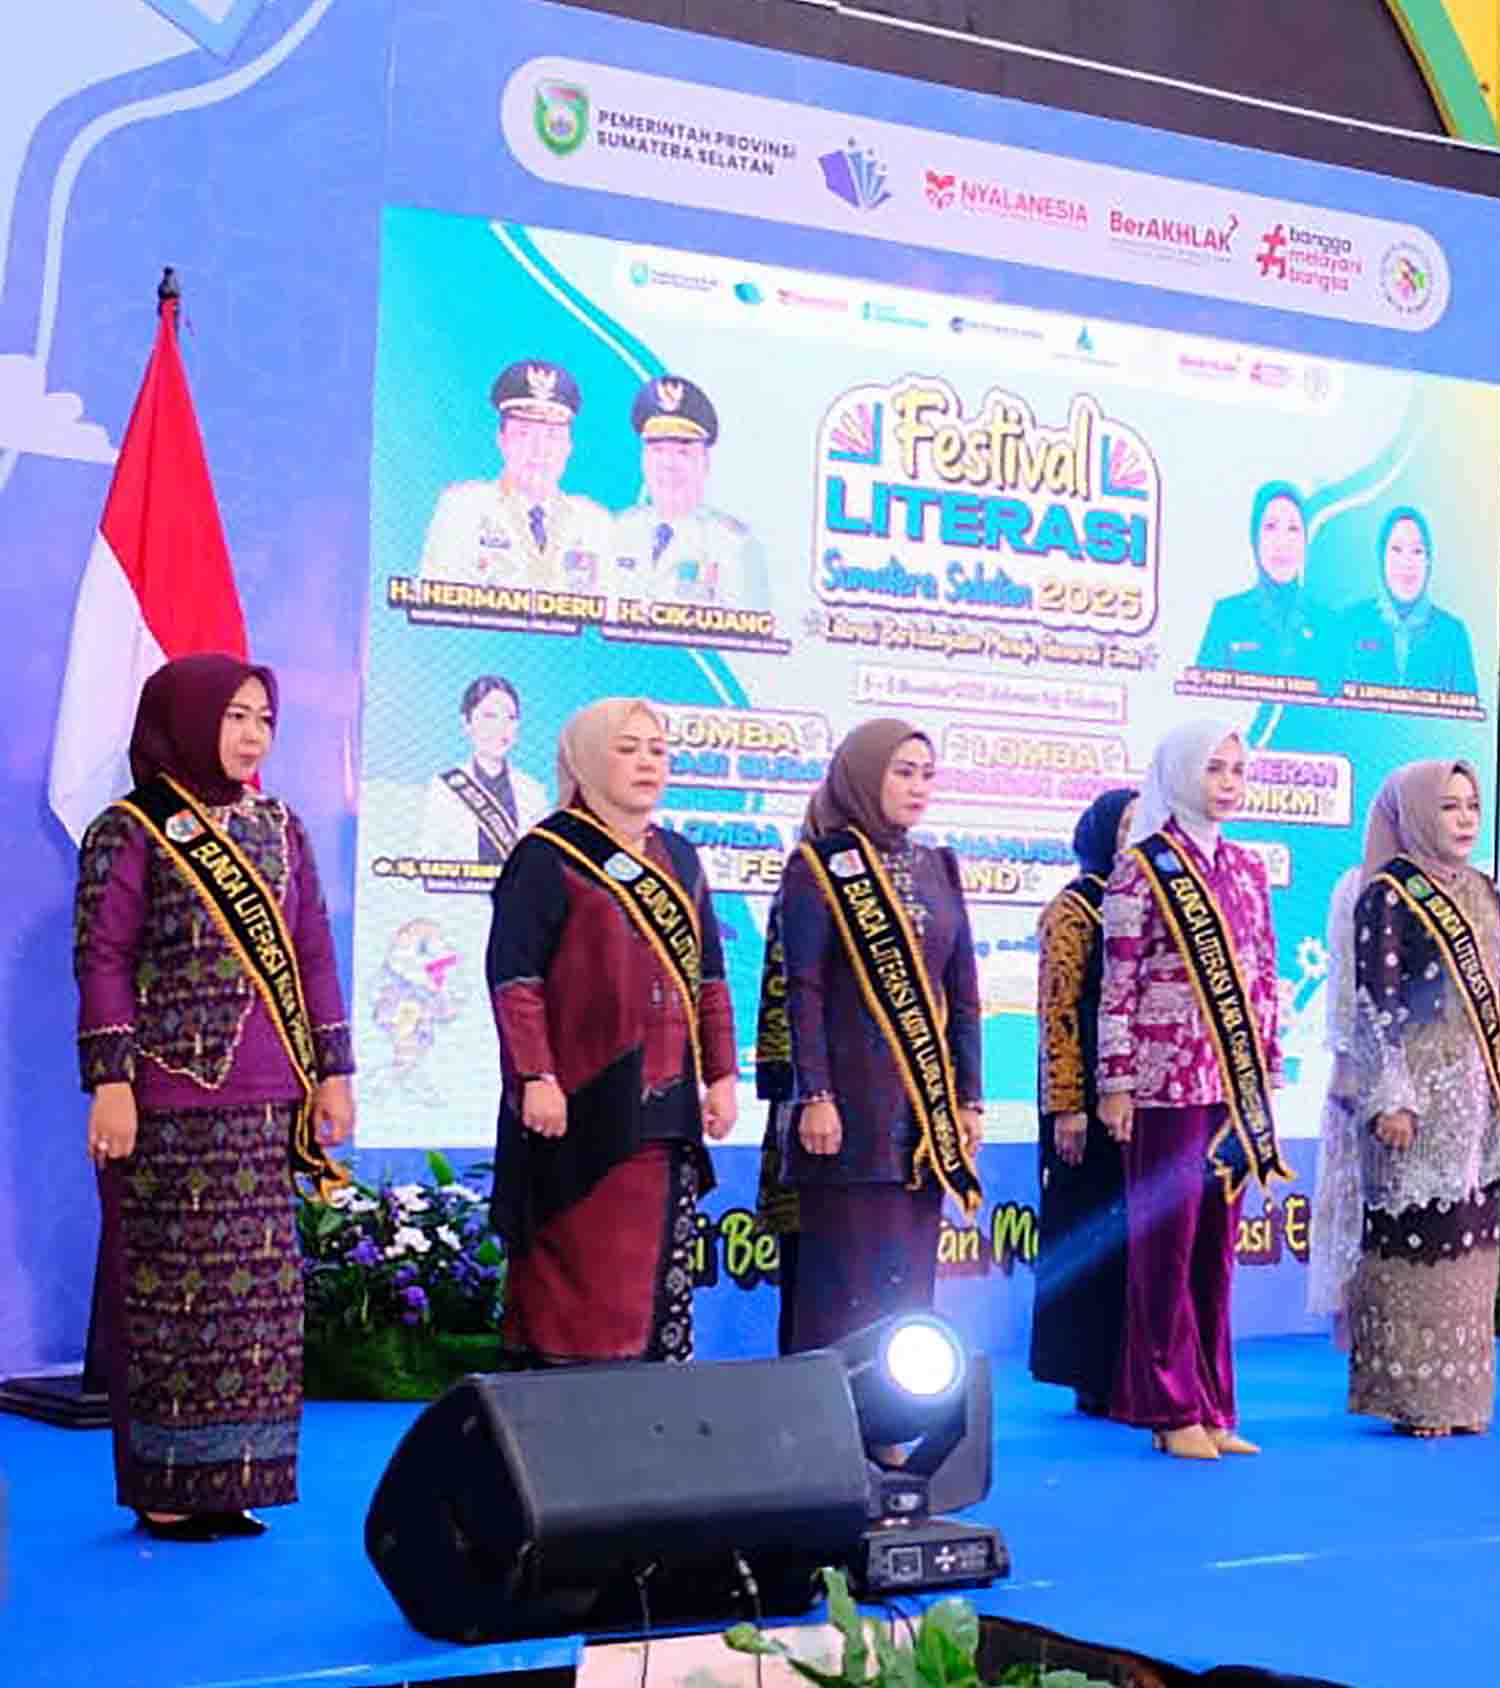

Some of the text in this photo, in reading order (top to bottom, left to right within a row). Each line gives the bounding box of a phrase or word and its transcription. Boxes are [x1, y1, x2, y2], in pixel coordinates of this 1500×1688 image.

[596, 130, 776, 176] SUMATERA SELATAN
[598, 109, 796, 159] PEMERINTAH PROVINSI
[960, 181, 1089, 224] NYALANESIA
[1109, 211, 1233, 253] BerAKHLAK
[1289, 226, 1352, 254] bangga
[1289, 247, 1364, 275] melayani
[1289, 267, 1350, 292] bangsa
[892, 388, 1093, 501] Festival
[826, 475, 1148, 567] LITERASI
[423, 583, 529, 613] HERMAN
[538, 592, 602, 618] DERU
[1039, 580, 1144, 621] 2025
[189, 841, 288, 976] BUNDA LITERASI
[633, 876, 682, 934] BUNDA
[843, 878, 890, 940] BUNDA
[868, 936, 917, 1010] LITERASI
[1170, 876, 1212, 934] BUNDA
[1194, 928, 1233, 998] LITERASI
[1454, 935, 1490, 999] LITERASI
